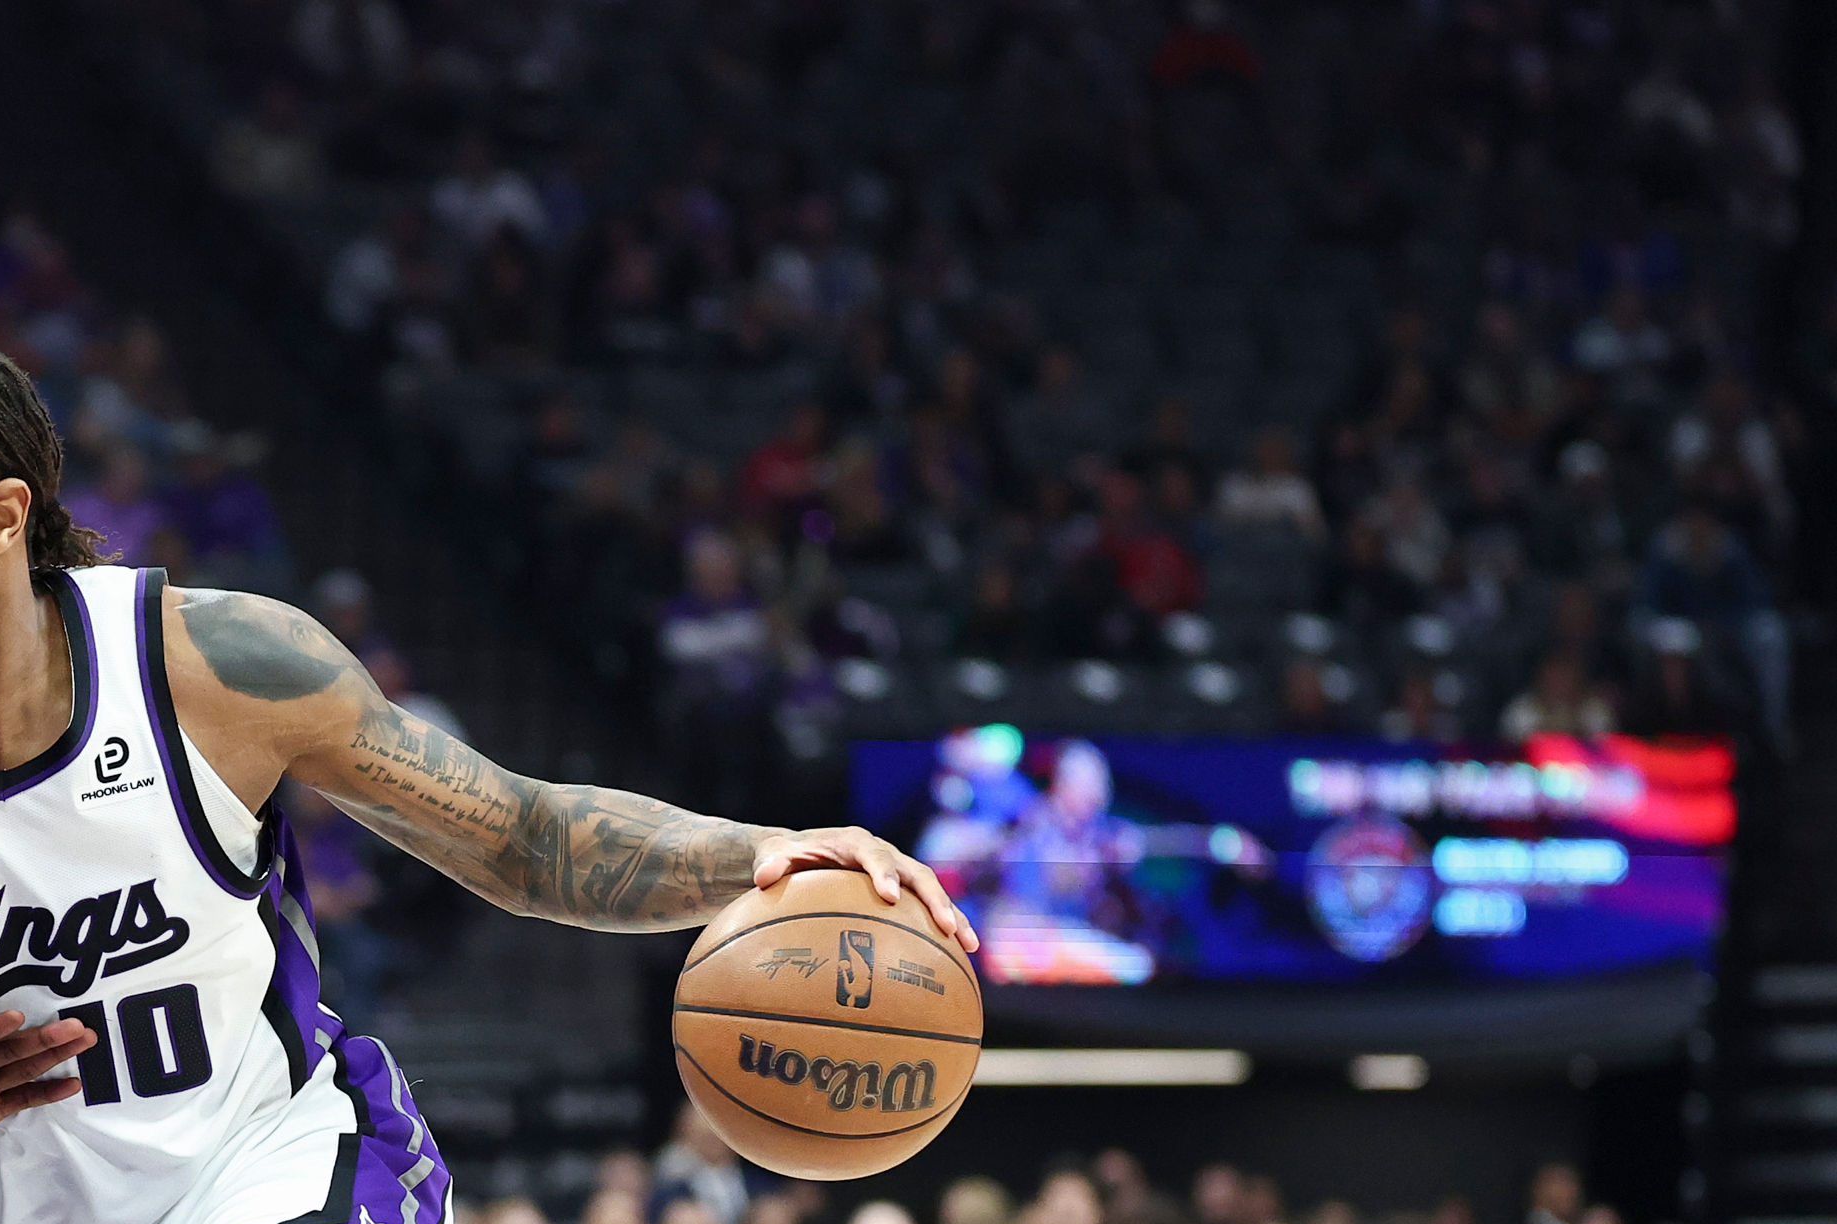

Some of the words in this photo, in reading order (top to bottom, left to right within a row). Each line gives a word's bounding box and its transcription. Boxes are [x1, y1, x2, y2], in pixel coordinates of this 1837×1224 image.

[81, 783, 129, 802] PHOONG
[130, 777, 155, 790] LAW
[59, 983, 213, 1106] 10
[739, 1033, 937, 1113] Wilson
